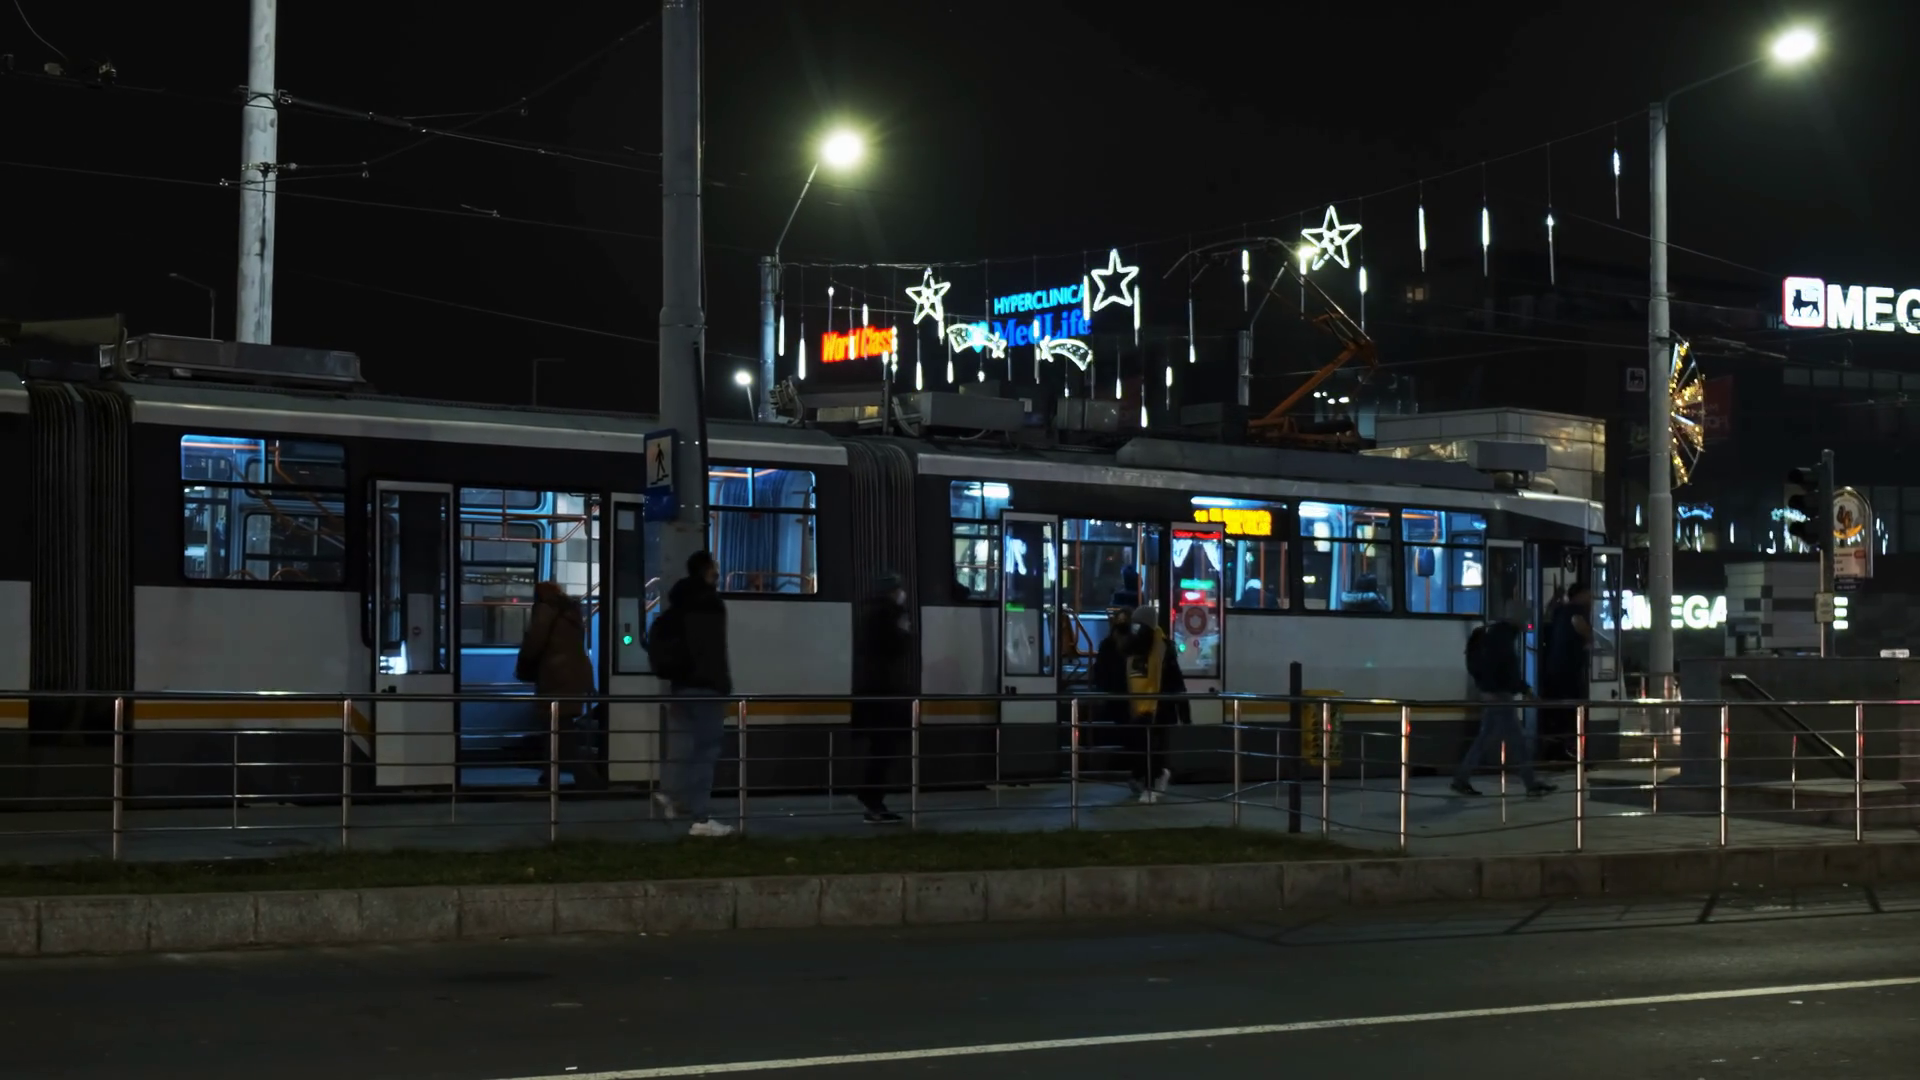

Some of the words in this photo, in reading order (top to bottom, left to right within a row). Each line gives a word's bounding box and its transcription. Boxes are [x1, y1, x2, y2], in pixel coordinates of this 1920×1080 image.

[994, 284, 1087, 315] HYPERCLINICA
[1827, 284, 1920, 334] MEG
[992, 308, 1092, 347] MedLife
[822, 330, 860, 363] Word
